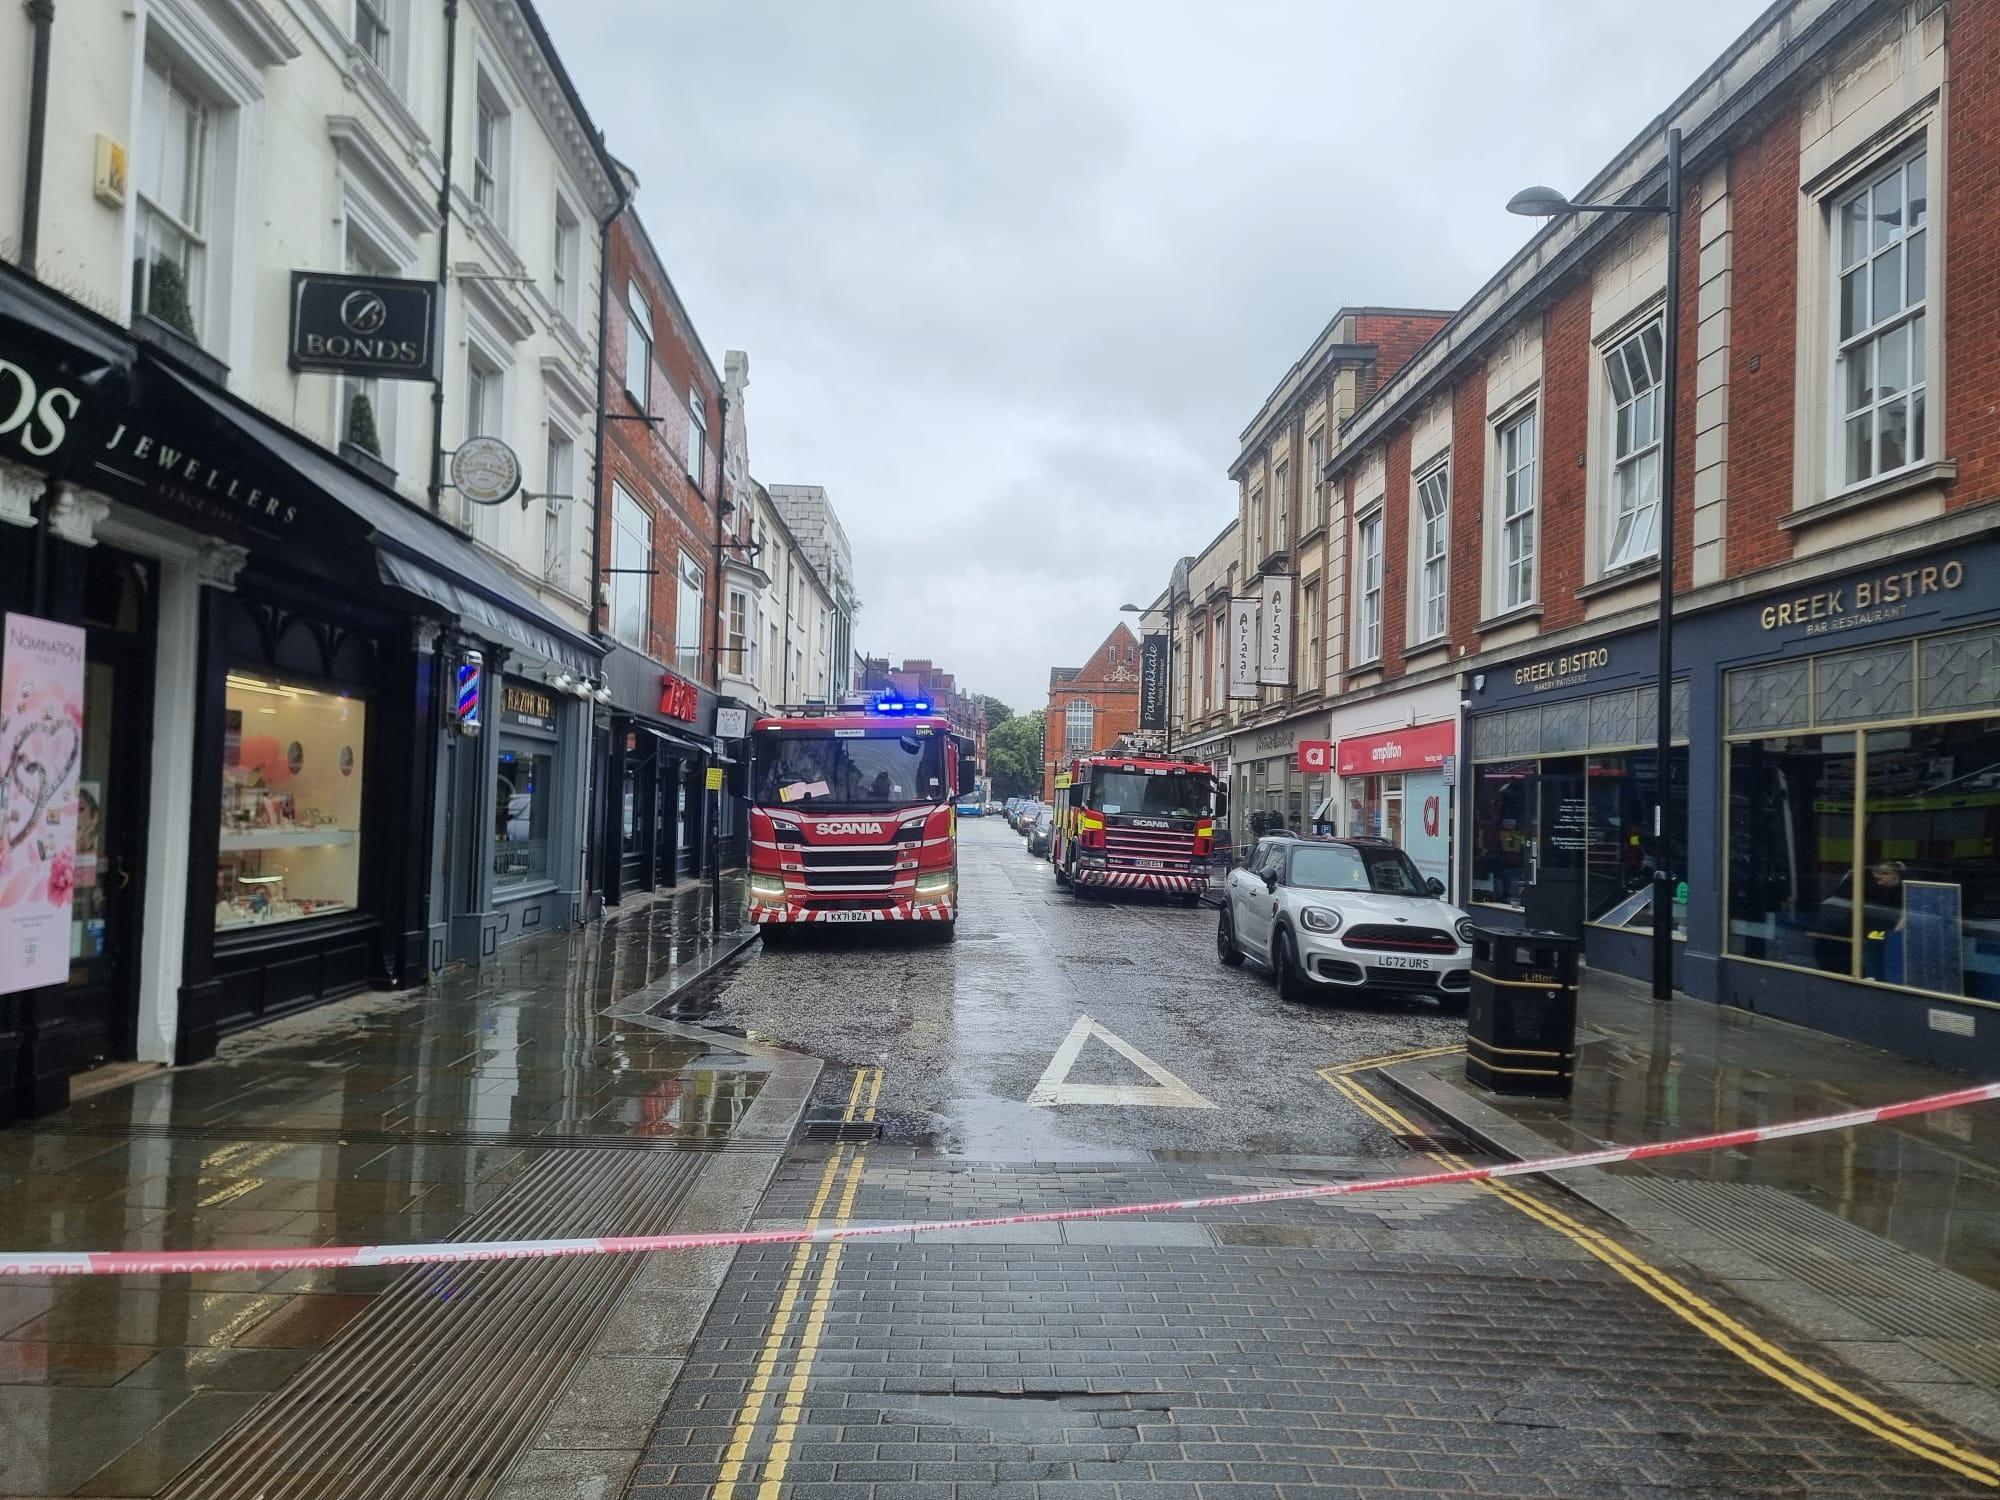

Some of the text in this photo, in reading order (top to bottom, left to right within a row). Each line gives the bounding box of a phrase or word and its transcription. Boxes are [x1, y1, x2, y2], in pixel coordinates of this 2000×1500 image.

[306, 333, 417, 362] BONDS
[106, 424, 297, 523] JEWELLERS
[1760, 560, 1964, 630] GREEK BISTRO
[1271, 590, 1282, 664] Abraxas
[1807, 604, 1907, 635] BAR RESTAURANT
[10, 627, 82, 664] NOMINATION
[1239, 612, 1248, 679] Abraxas
[1515, 647, 1608, 685] GREEK BISTRO
[1144, 643, 1158, 720] Pamukkale
[1534, 673, 1588, 691] BAKERY PATISSERIE
[1372, 741, 1402, 765] amplifon
[816, 823, 883, 835] SCANIA
[1133, 819, 1170, 828] SCANIA
[831, 912, 868, 921] KX71 BZA
[1378, 956, 1430, 969] LG72 URS
[1525, 972, 1552, 982] Litter
